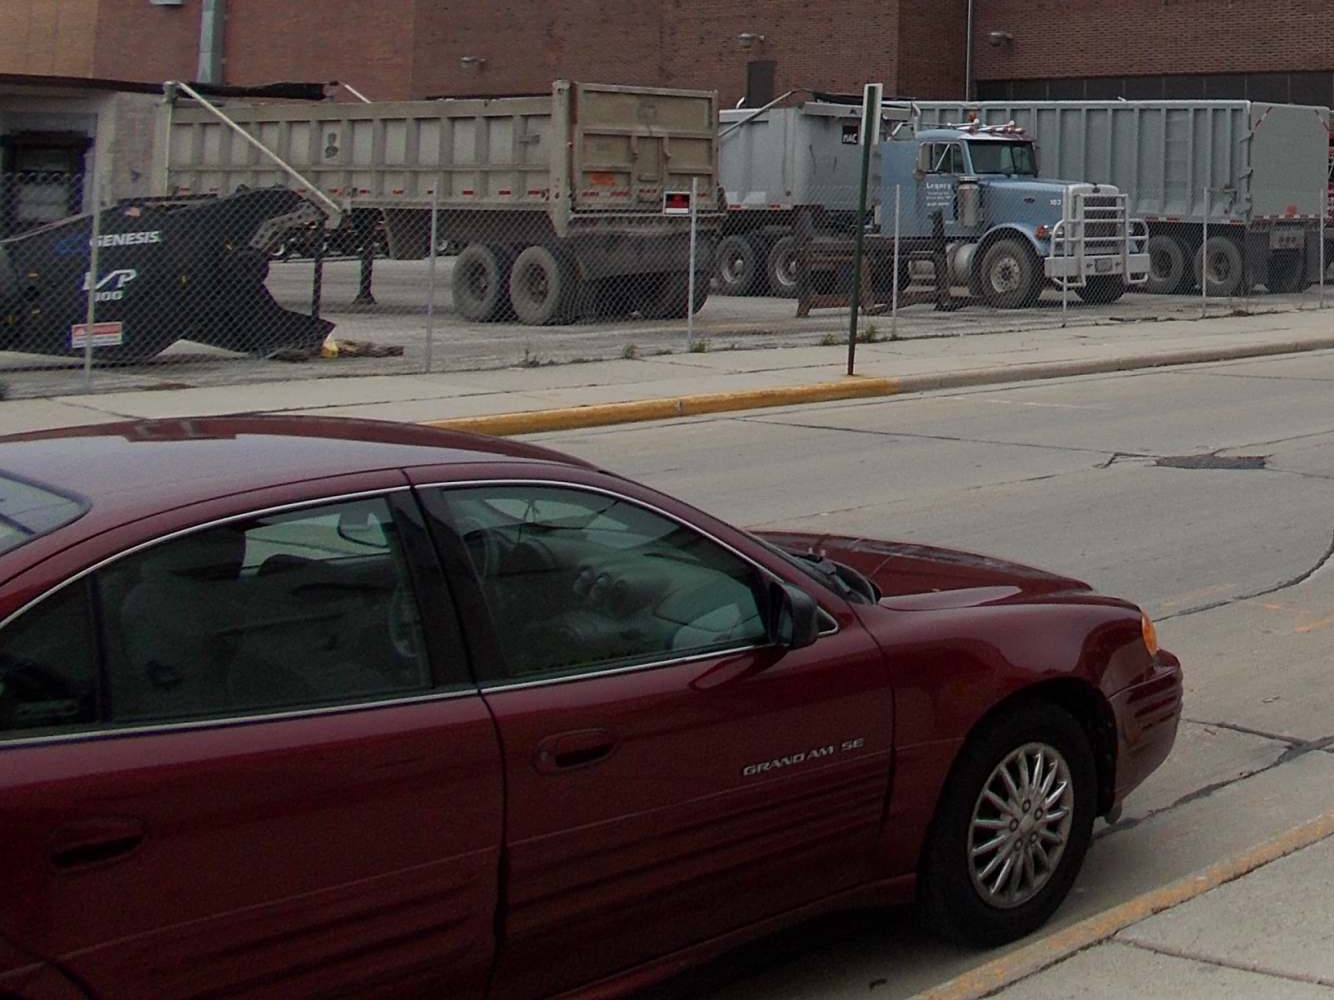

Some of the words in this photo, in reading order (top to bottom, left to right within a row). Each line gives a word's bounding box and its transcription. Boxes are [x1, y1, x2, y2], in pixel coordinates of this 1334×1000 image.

[89, 231, 161, 247] GENESIS
[743, 753, 805, 776] GRAND
[807, 745, 834, 761] AM
[841, 738, 864, 752] SE
